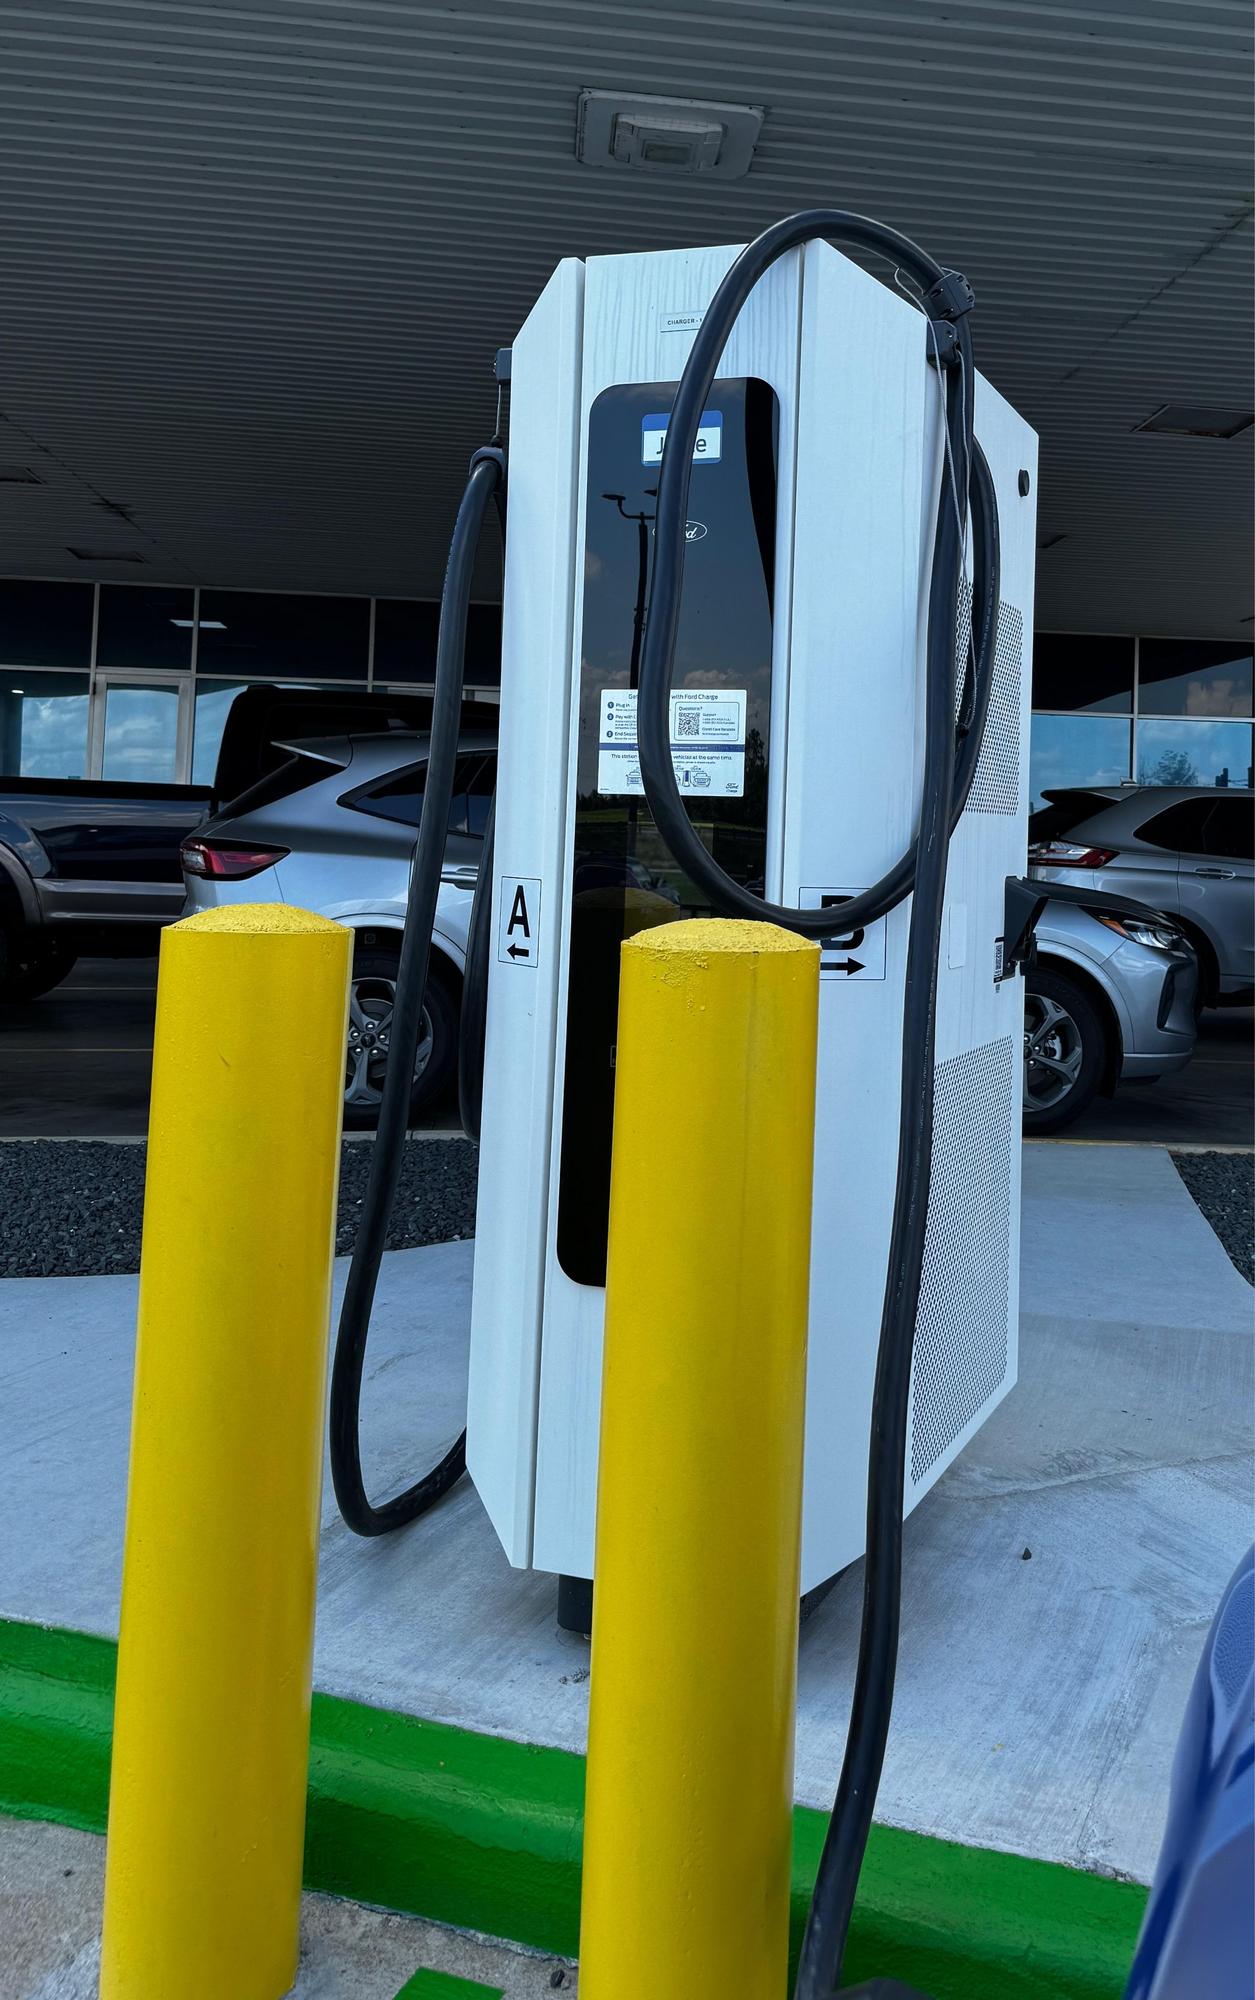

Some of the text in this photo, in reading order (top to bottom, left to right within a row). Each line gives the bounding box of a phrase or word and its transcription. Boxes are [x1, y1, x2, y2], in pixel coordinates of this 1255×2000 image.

[667, 318, 695, 326] CHARGER
[656, 436, 707, 455] Je
[507, 885, 530, 938] A
